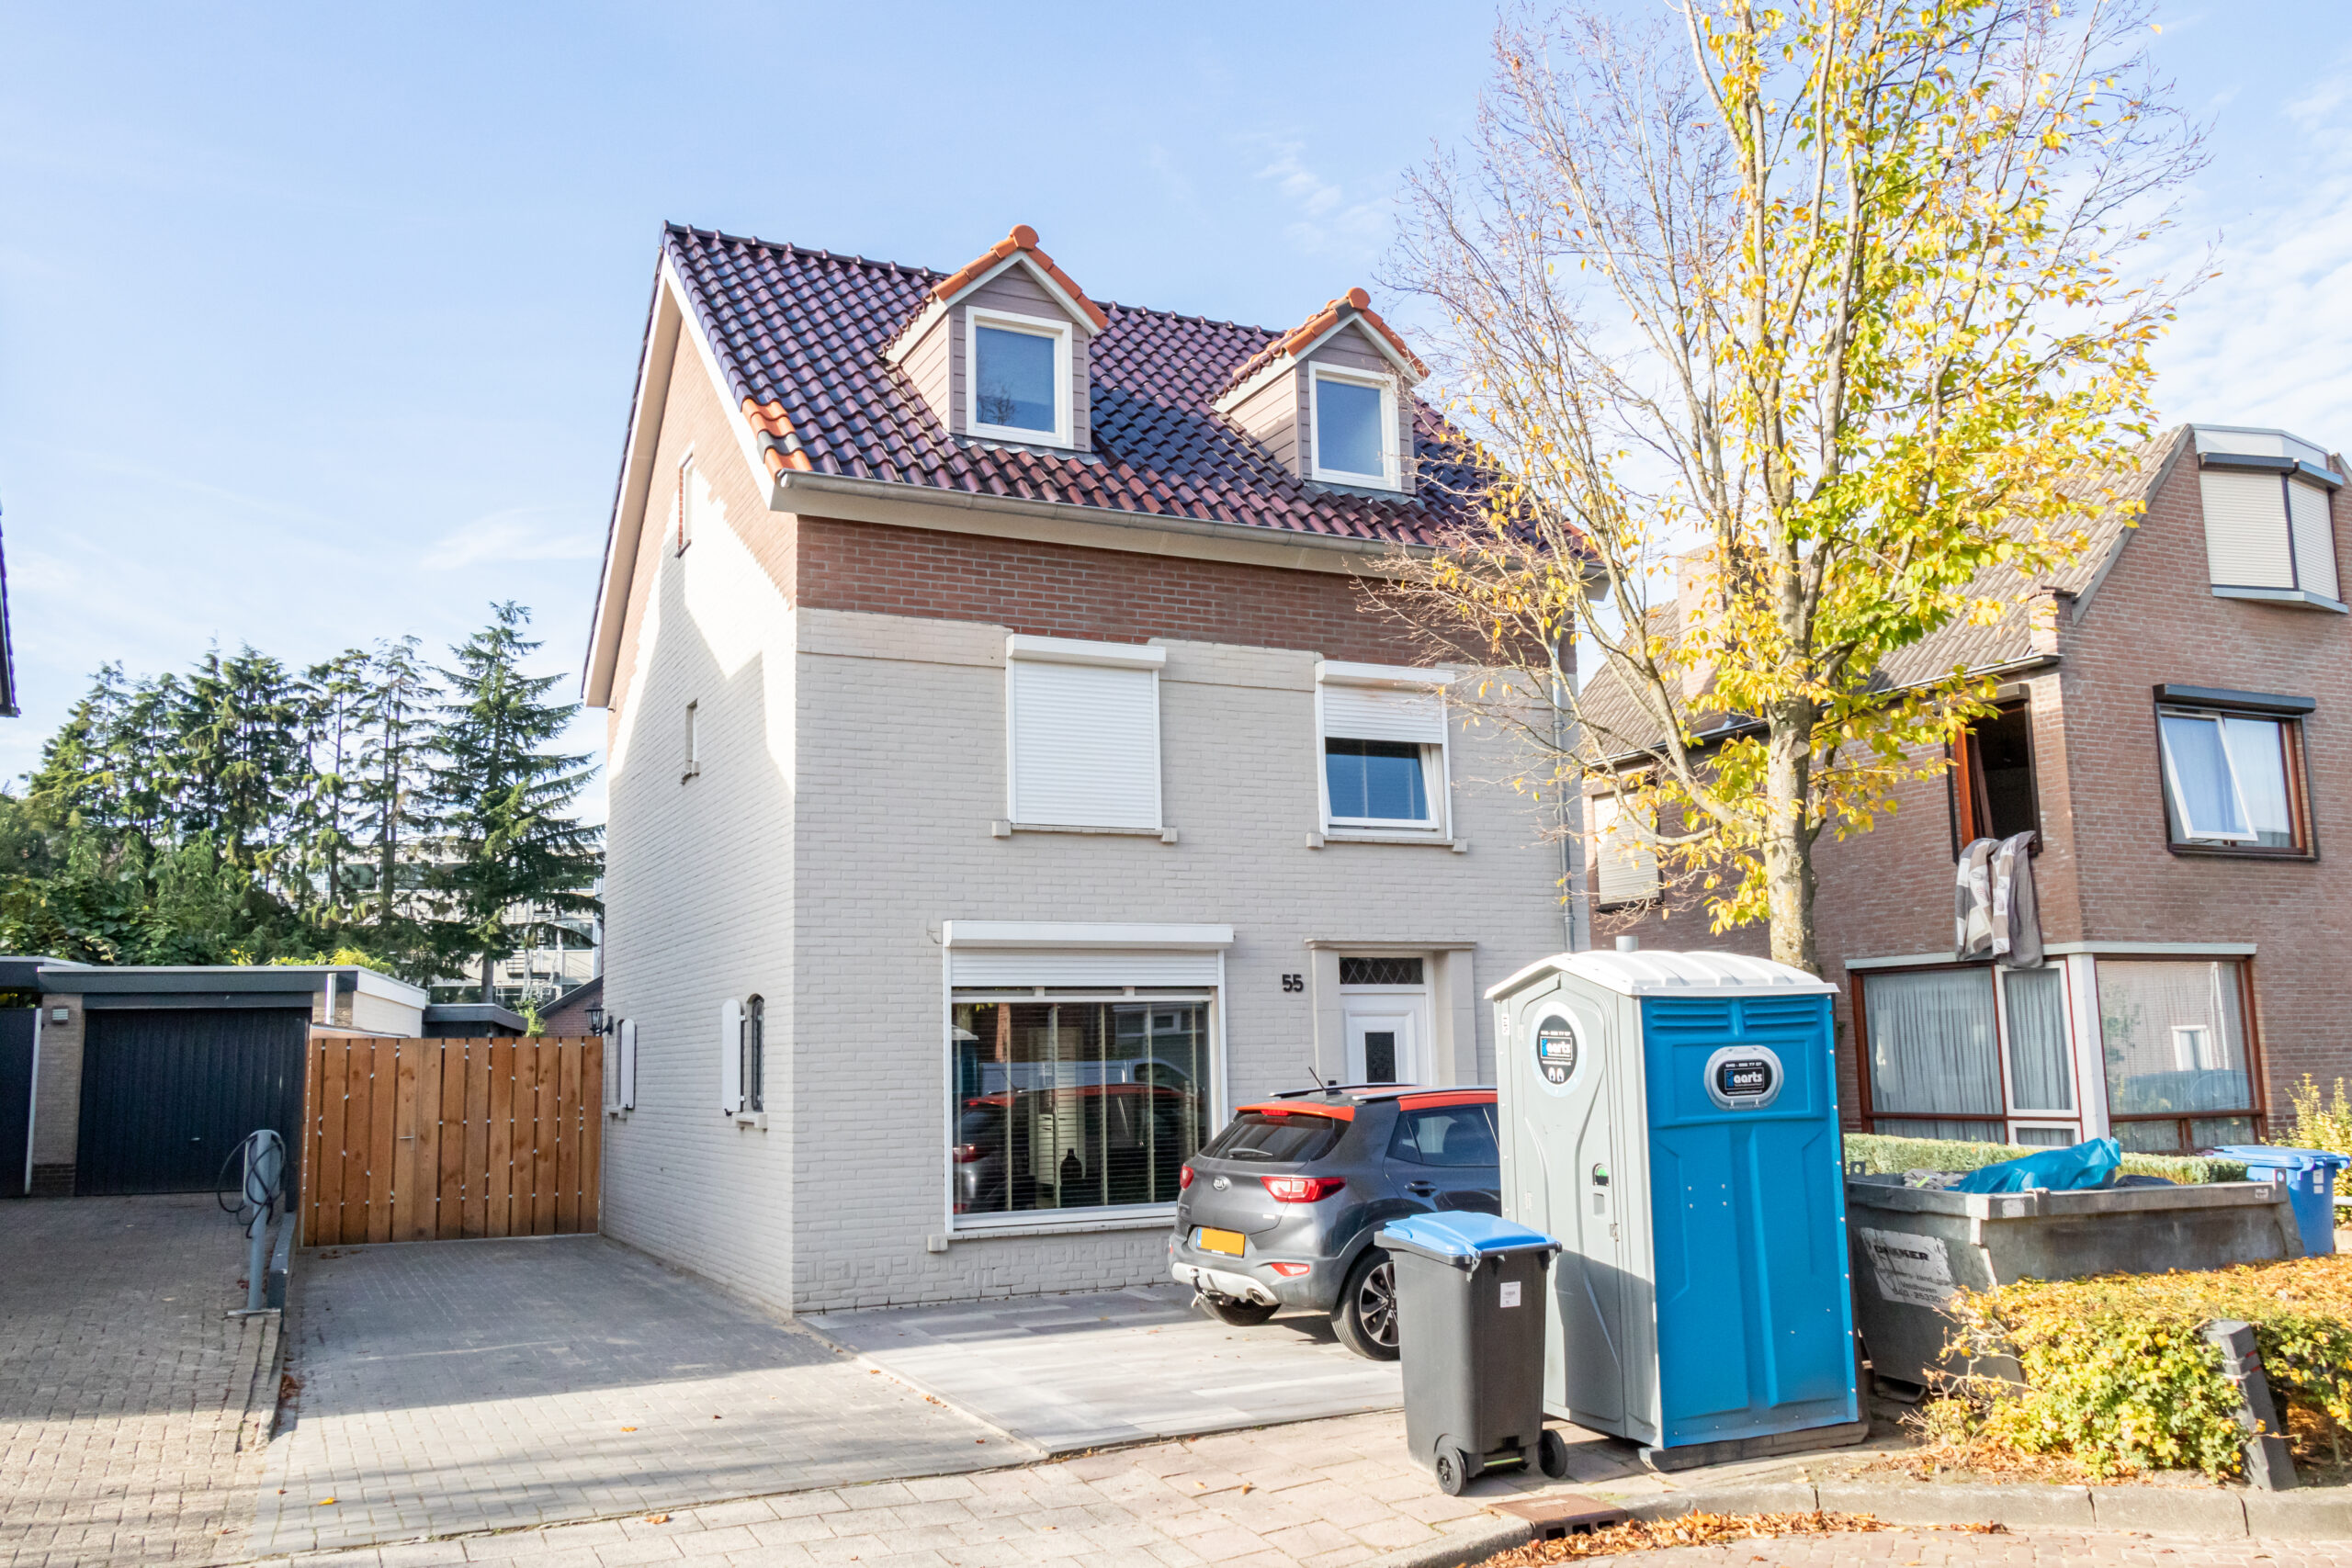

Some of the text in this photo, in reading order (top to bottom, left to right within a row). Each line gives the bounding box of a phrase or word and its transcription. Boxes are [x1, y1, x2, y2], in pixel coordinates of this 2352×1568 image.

[1282, 974, 1304, 992] 55
[1733, 1071, 1763, 1084] aarts
[1900, 1280, 1938, 1294] Veldhoven
